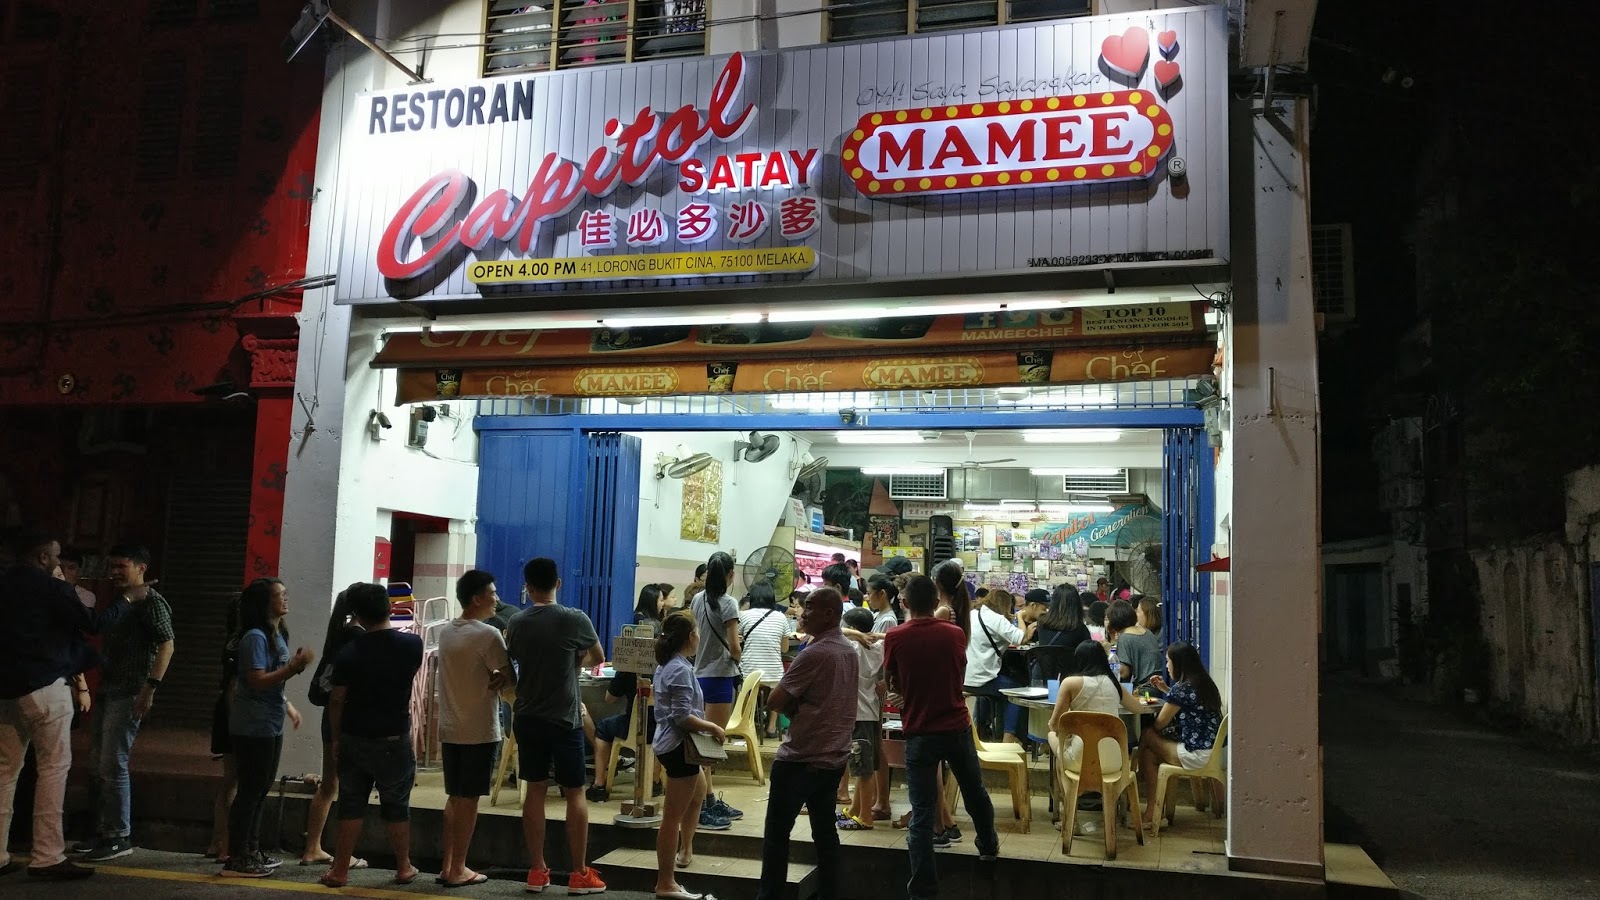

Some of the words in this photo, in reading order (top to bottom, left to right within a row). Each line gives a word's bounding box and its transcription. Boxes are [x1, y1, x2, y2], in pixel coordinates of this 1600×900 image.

[369, 79, 535, 135] RESTORAN
[877, 111, 1135, 174] MAMEE
[376, 51, 757, 280] Capitol
[679, 148, 819, 194] SATAY
[578, 197, 818, 247] 佳必多沙爹
[473, 263, 514, 279] OPEN
[518, 262, 549, 277] 4.00
[554, 261, 576, 275] PM
[650, 257, 683, 271] BUKIT
[685, 256, 717, 270] CINA,
[720, 254, 753, 268] 75100
[756, 251, 809, 266] MELAKA.
[1102, 308, 1142, 318] TOP
[1148, 306, 1166, 316] 10
[962, 327, 1074, 341] MAMEECHEF
[763, 368, 833, 391] Chef
[878, 365, 971, 384] MAMEE
[1085, 355, 1166, 380] Chef
[486, 374, 547, 395] Chef
[587, 374, 666, 391] MAMEE
[856, 415, 869, 426] 41
